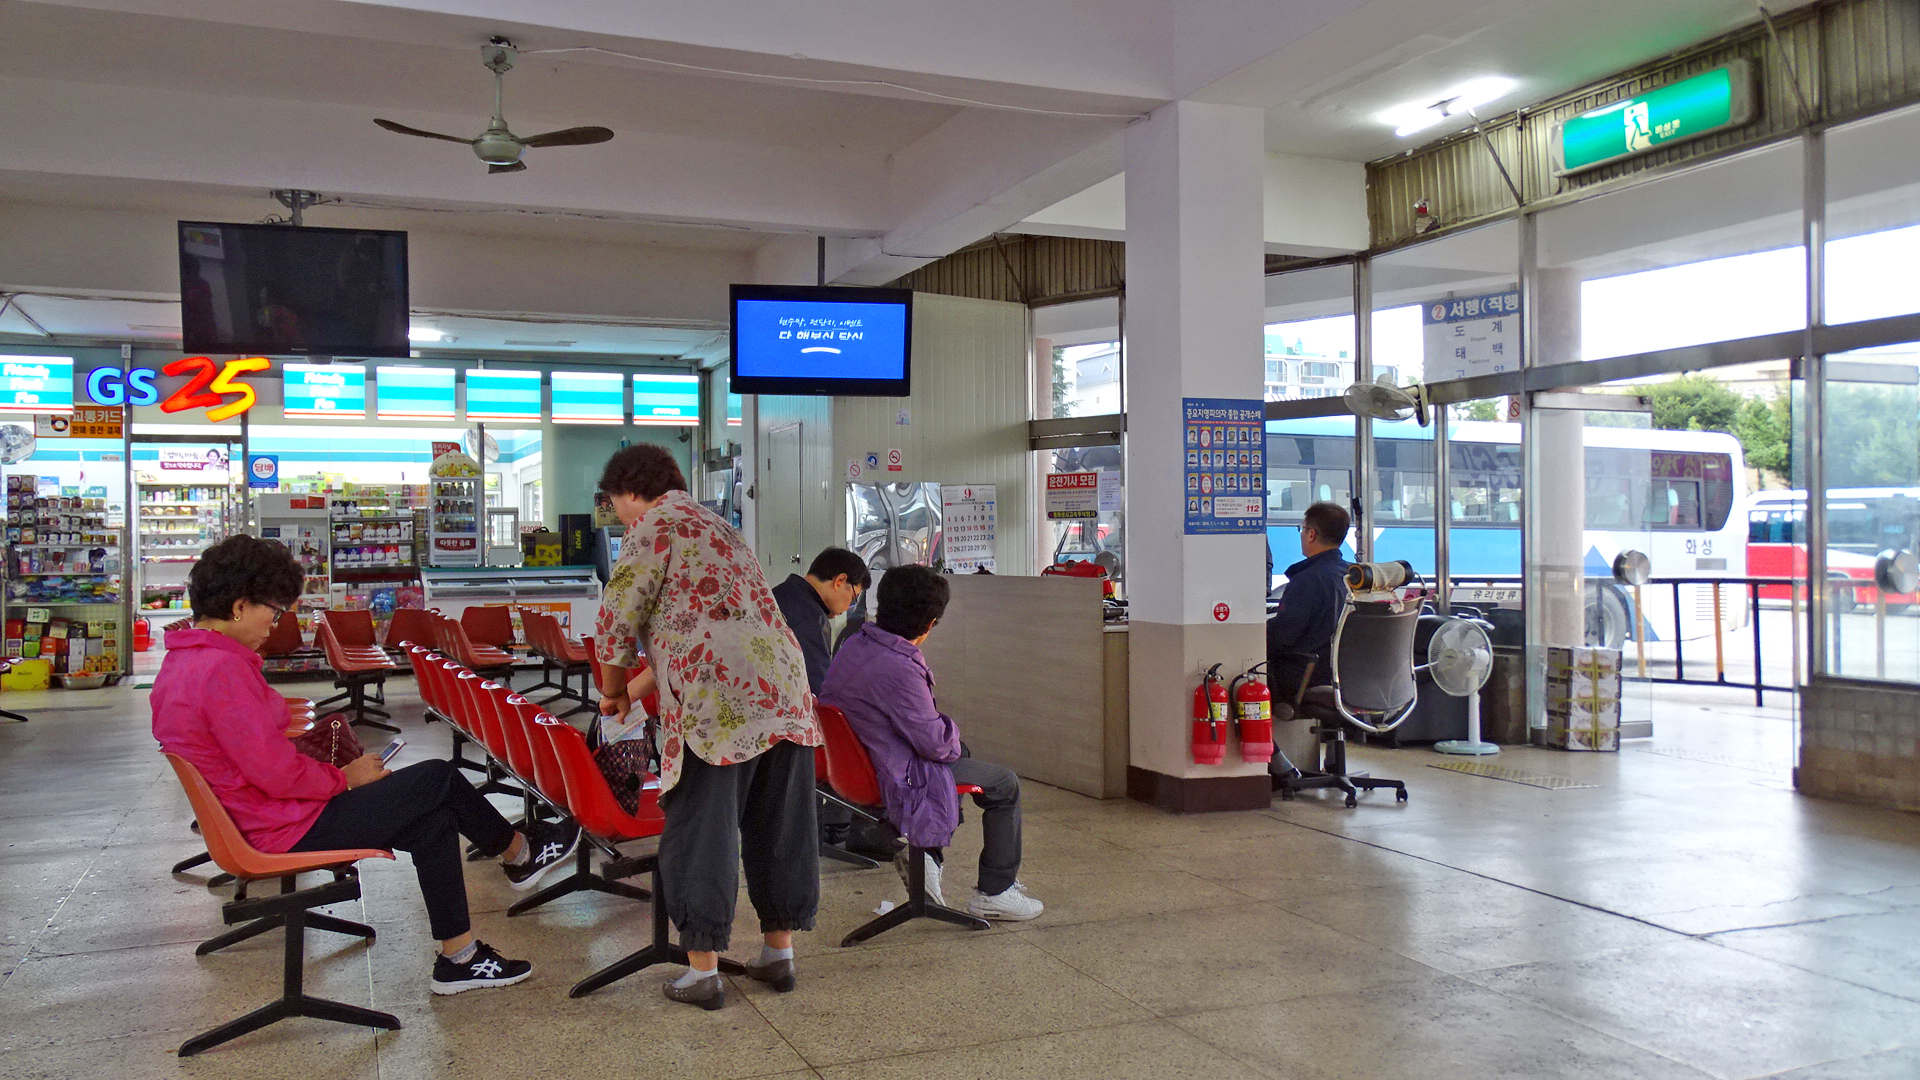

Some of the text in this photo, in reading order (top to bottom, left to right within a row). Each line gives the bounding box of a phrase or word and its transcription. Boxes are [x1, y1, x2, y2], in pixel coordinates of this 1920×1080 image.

[1434, 306, 1442, 319] 2
[72, 410, 121, 423] 교통카드
[1239, 409, 1262, 420] 공개수배
[254, 463, 274, 472] 담배
[1049, 474, 1096, 488] 운전기사 모집
[964, 489, 972, 499] 9
[1246, 504, 1260, 513] 112
[1685, 538, 1712, 556] 화성
[1473, 590, 1517, 599] 유리병류
